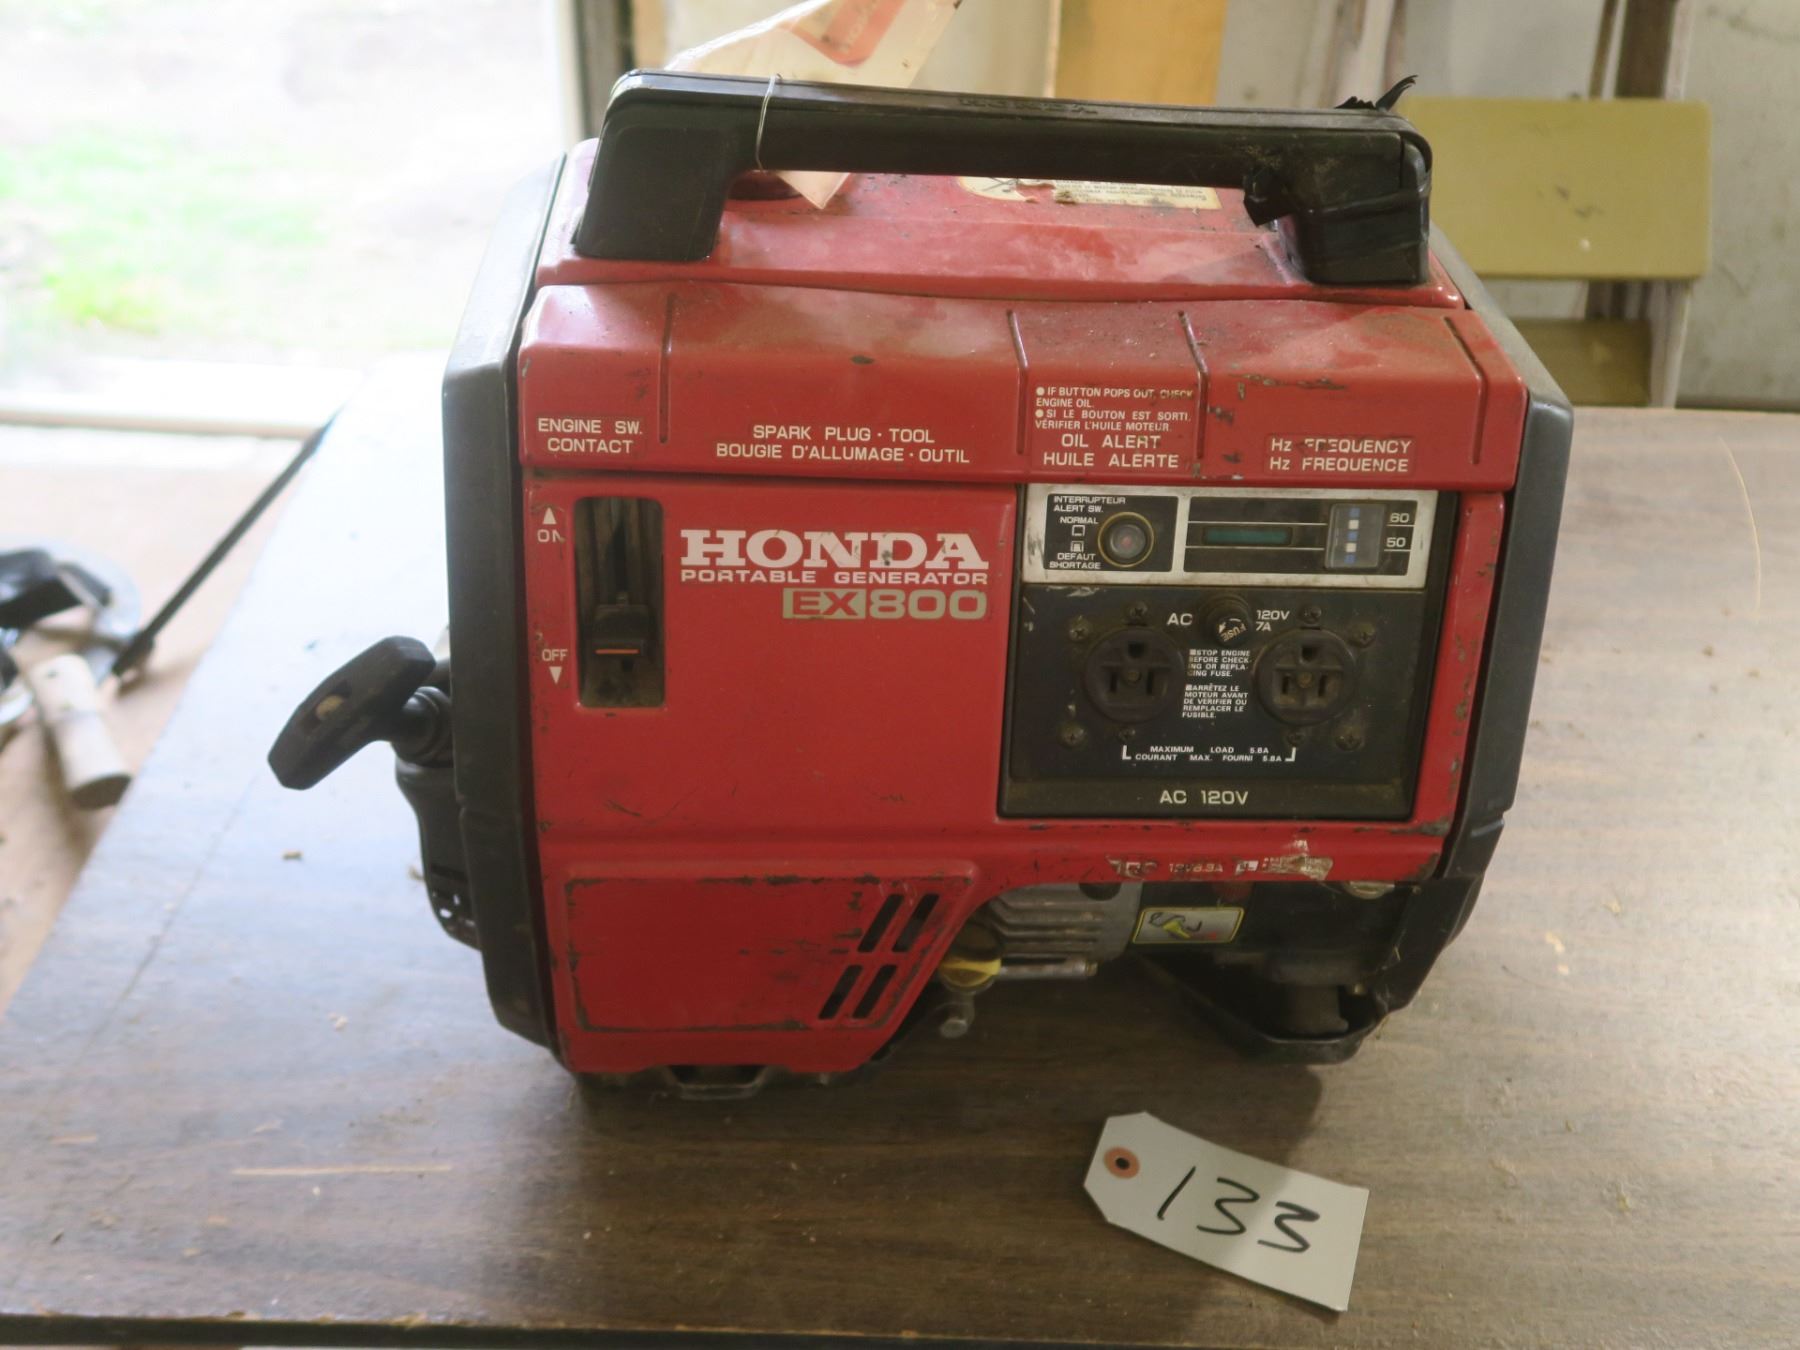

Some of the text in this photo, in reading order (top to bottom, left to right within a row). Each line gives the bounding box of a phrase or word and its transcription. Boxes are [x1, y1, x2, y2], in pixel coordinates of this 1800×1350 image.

[1047, 387, 1056, 396] IF
[1058, 387, 1101, 397] BUTTON
[1103, 389, 1130, 398] POPS
[1036, 398, 1073, 407] ENGINE
[1046, 409, 1057, 418] SI
[1063, 410, 1075, 419] LE
[1081, 411, 1125, 420] BOUTON
[1132, 411, 1151, 420] EST
[538, 417, 643, 435] ENGINE SW.
[1084, 421, 1122, 431] L'HUILE
[753, 425, 935, 443] SPARK PLUG TOOL
[547, 437, 634, 454] CONTACT
[1061, 433, 1161, 449] OIL ALERT
[1271, 438, 1292, 452] Hz
[716, 443, 970, 464] BOUGIE D'ALLUMAGE OUTIL
[1043, 452, 1180, 468] HUILE ALERTE
[1269, 457, 1409, 473] Hz FREQUENCE
[1053, 496, 1126, 504] INTERRUPTEUR
[1053, 504, 1104, 513] ALERT SW.
[1059, 516, 1099, 525] NORMAL
[1390, 513, 1410, 524] 60
[537, 529, 562, 543] ON
[1386, 536, 1407, 548] 50
[680, 528, 990, 570] HONDA
[1057, 553, 1096, 561] DEFAUT
[1048, 561, 1101, 570] SHORTAGE
[680, 569, 989, 585] PORTABLE GENERATOR
[782, 587, 989, 621] EX800
[1166, 612, 1193, 626] AC
[1255, 609, 1290, 621] 120V
[1255, 621, 1272, 632] 7A
[541, 649, 568, 662] OFF
[1150, 745, 1194, 753] MAXIMUM
[1210, 746, 1235, 754] LOAD
[1135, 753, 1177, 761] COURANT
[1189, 754, 1213, 762] MAX.
[1159, 790, 1249, 806] AC 120V
[1156, 1165, 1321, 1254] 133
